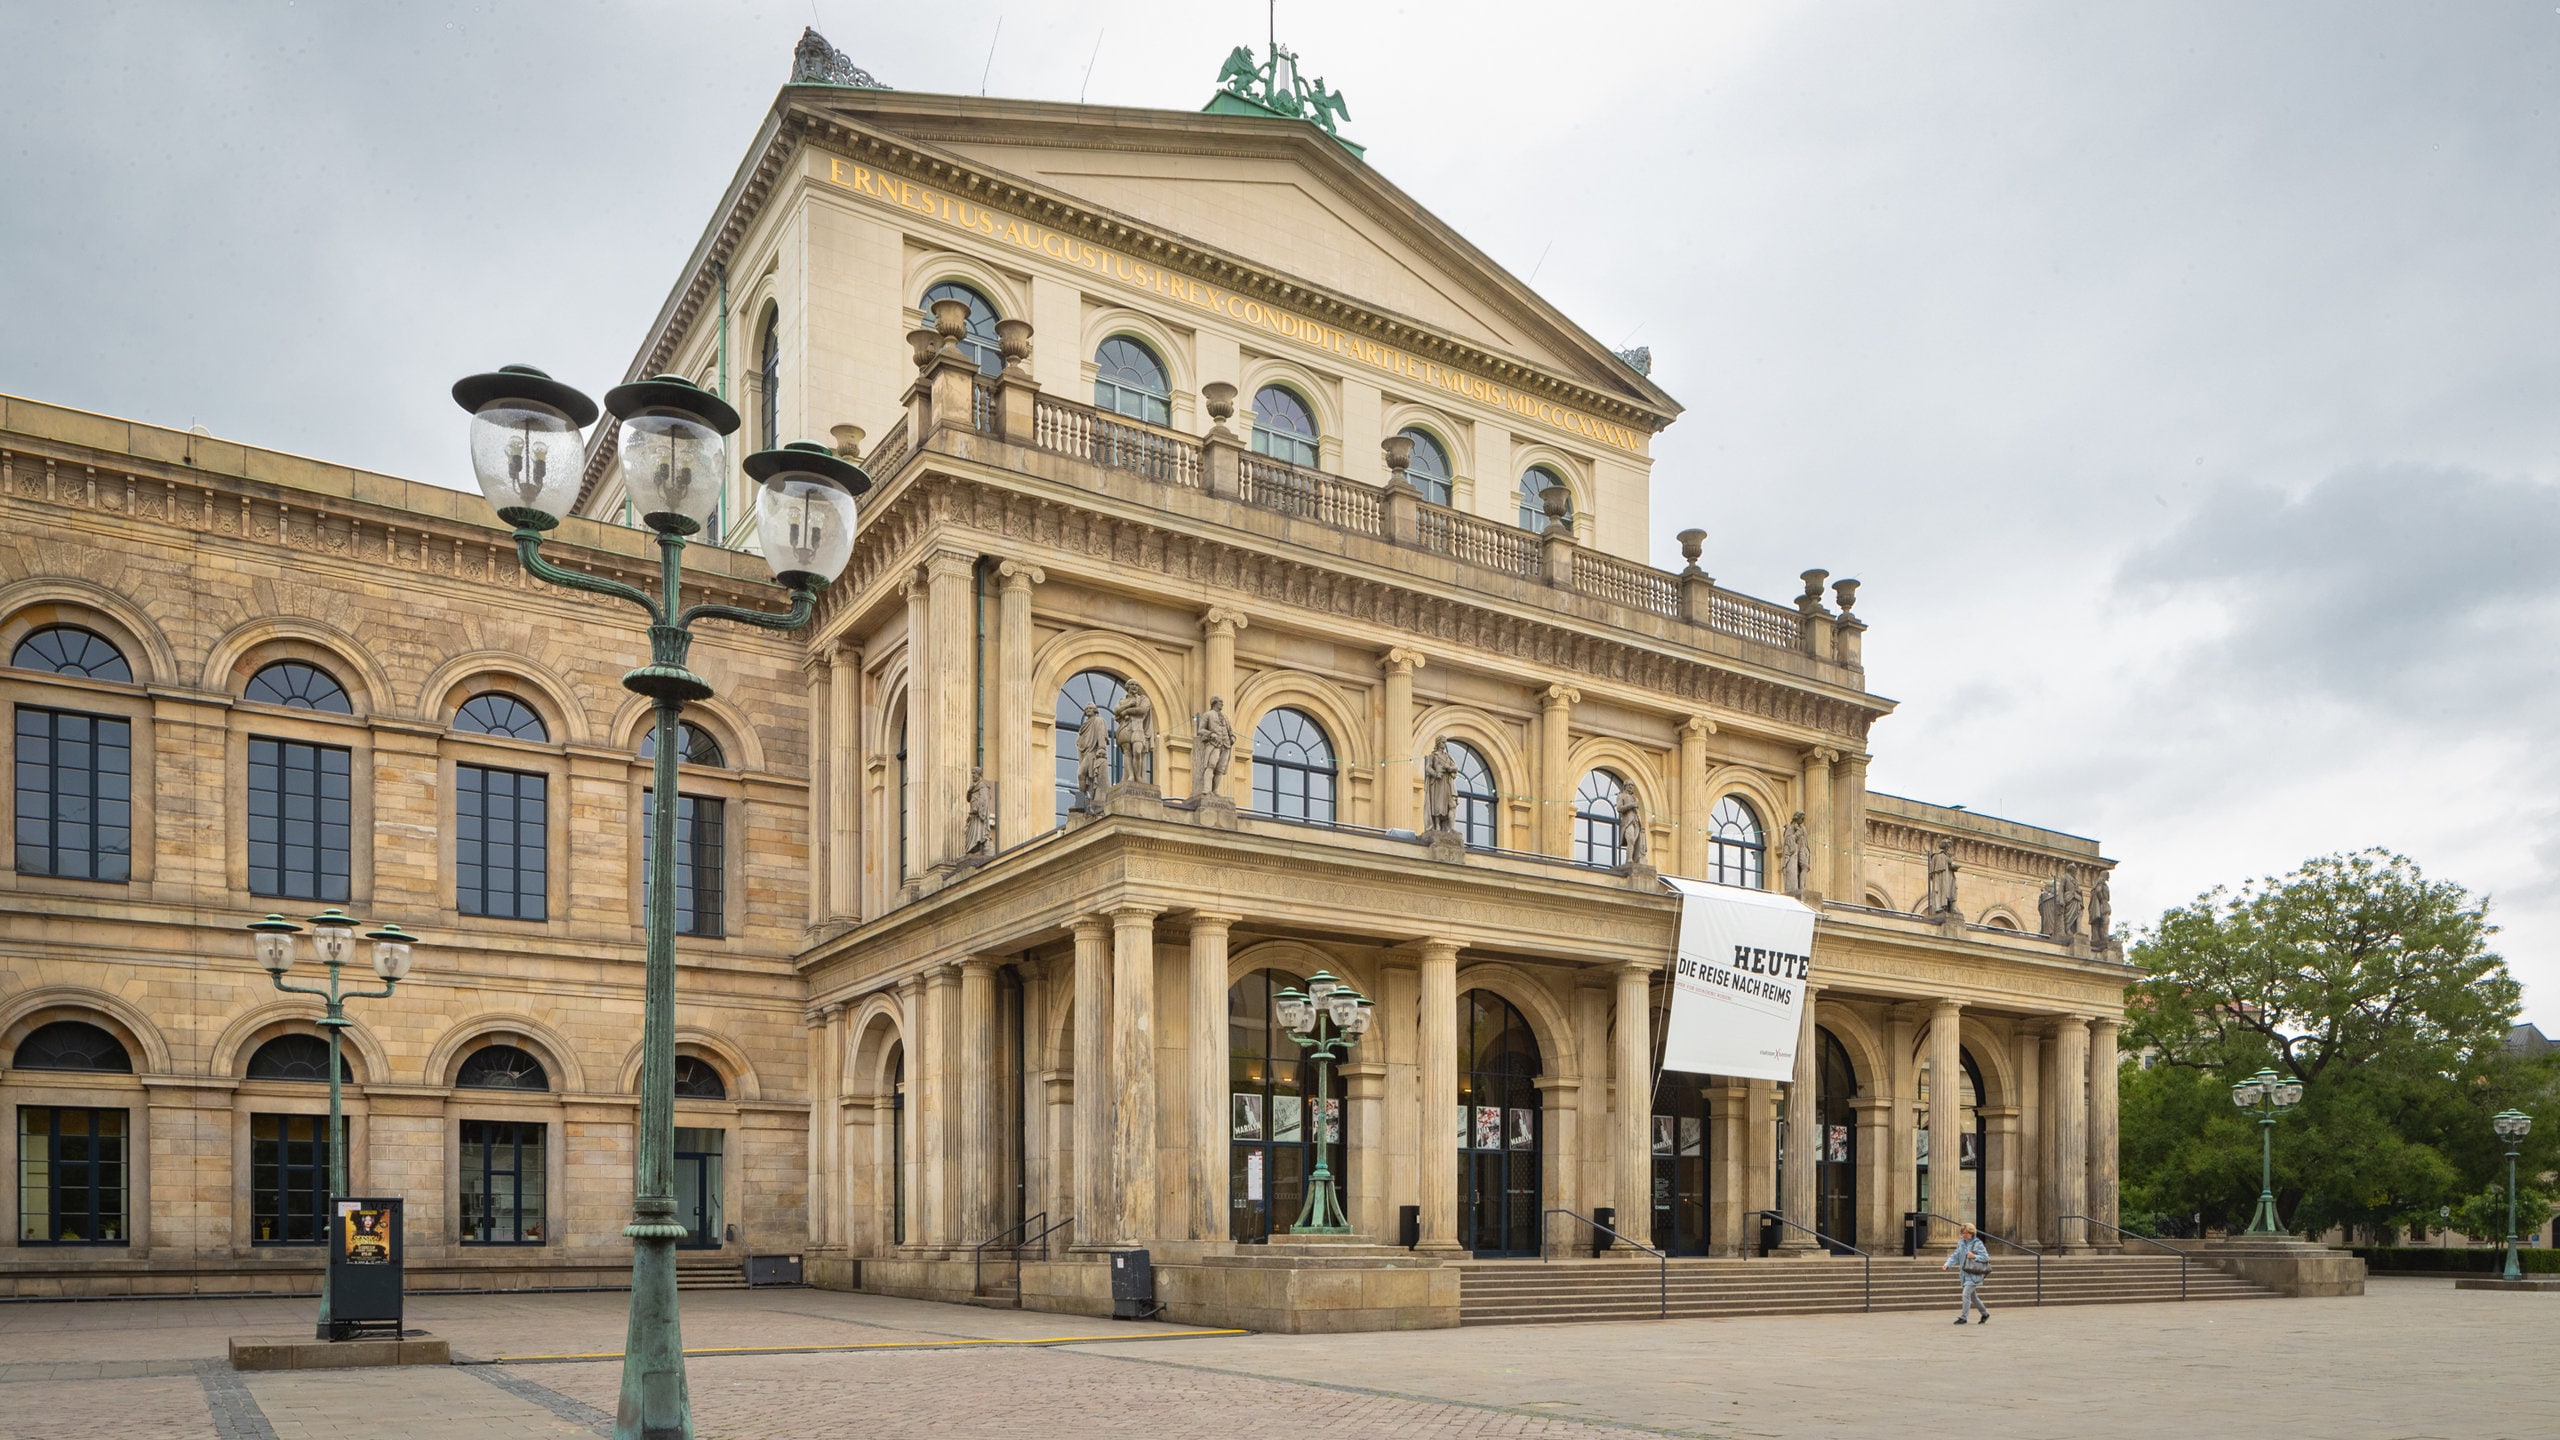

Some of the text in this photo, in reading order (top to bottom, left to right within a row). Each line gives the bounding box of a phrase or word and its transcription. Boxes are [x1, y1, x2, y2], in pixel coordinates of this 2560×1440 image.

[829, 158, 994, 236] ERNESTUS
[1003, 221, 1148, 287] AUGUSTUS
[1169, 274, 1221, 313] REX
[1227, 296, 1345, 353] CONDIDIT
[1347, 337, 1401, 372] ARTI
[1405, 355, 1436, 384] ET
[1440, 367, 1502, 405] MUSIS
[1678, 957, 1697, 978] DIE
[1698, 963, 1731, 987] REISE
[1731, 973, 1761, 996] NACH
[1761, 982, 1792, 1005] REIMS
[1733, 945, 1809, 980] HEUTE
[1235, 1122, 1261, 1135] MARILYN
